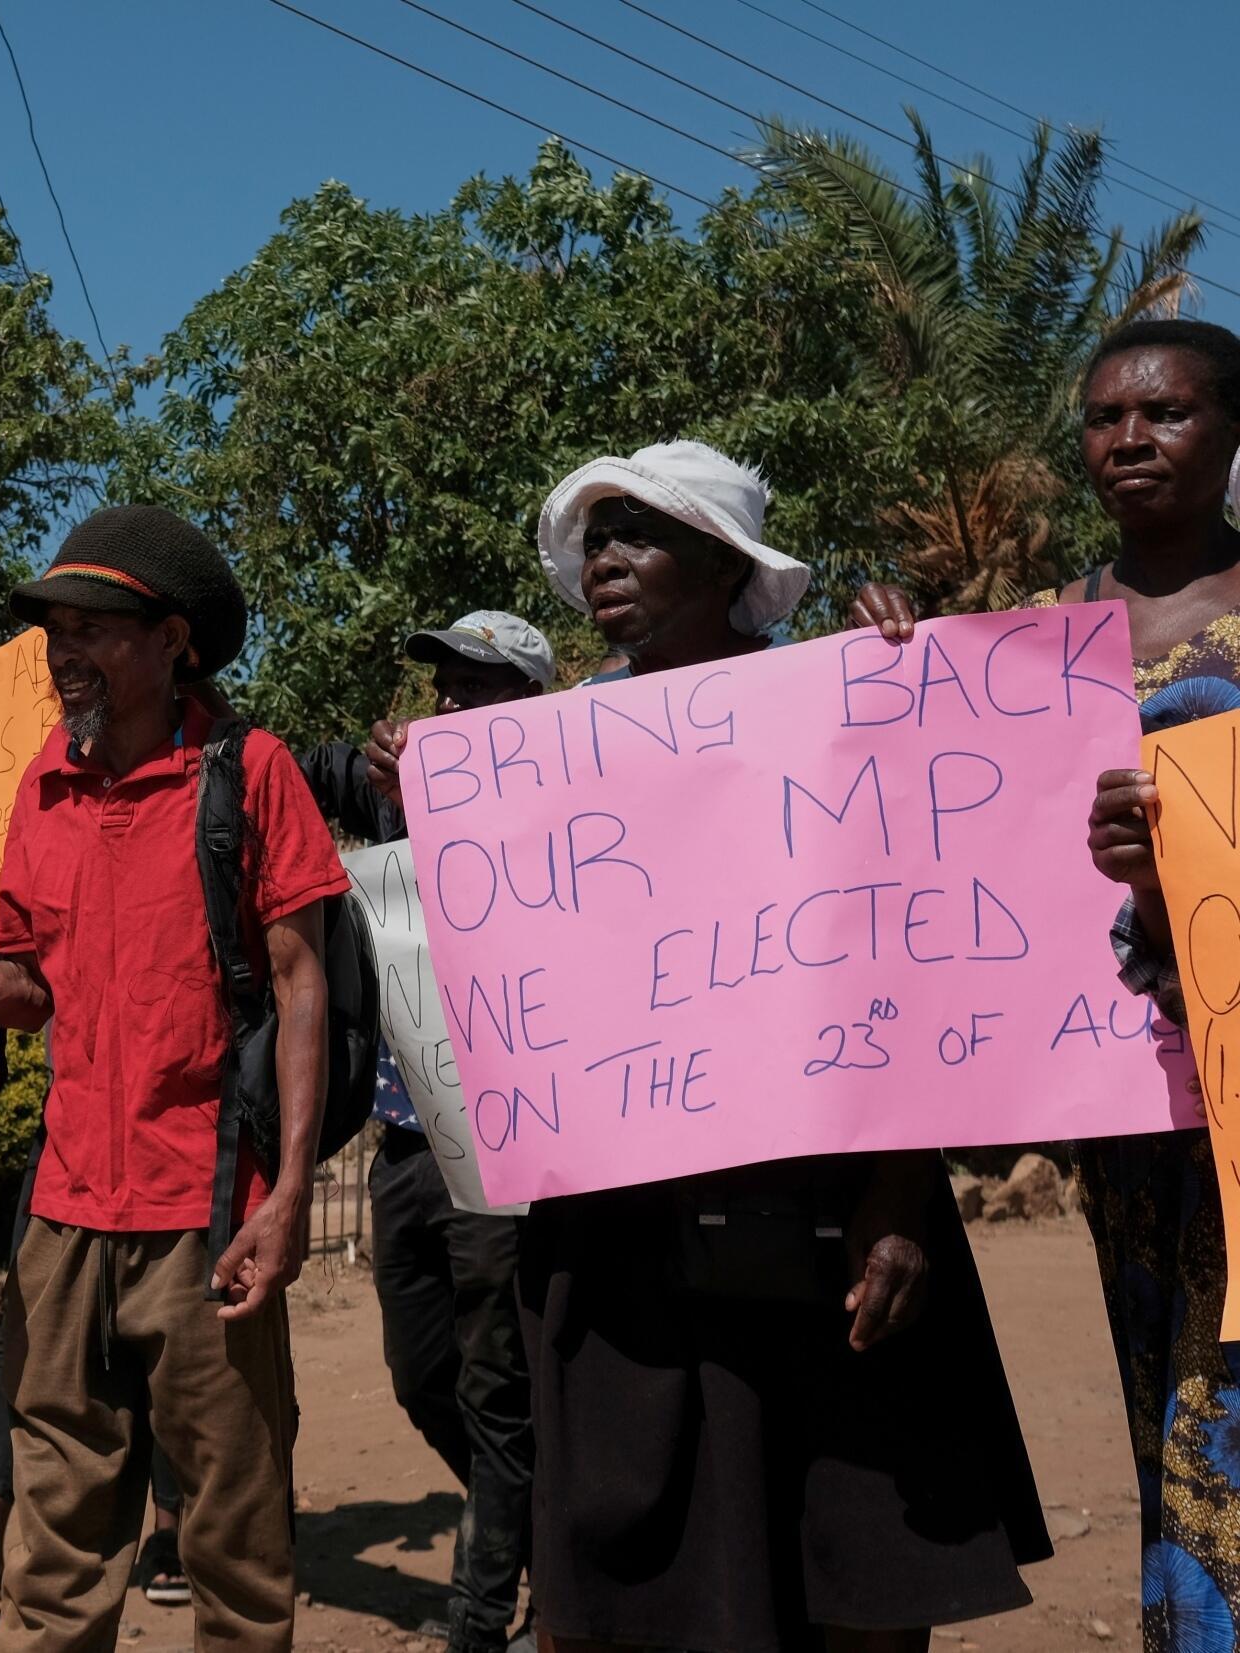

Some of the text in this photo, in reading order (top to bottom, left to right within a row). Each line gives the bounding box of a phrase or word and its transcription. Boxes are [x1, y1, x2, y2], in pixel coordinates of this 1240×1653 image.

[417, 611, 1138, 814] BRING BACK
[436, 811, 654, 932] OUR
[783, 750, 1004, 862] MP
[443, 966, 569, 1056] WE
[650, 876, 1030, 1012] ELECTED
[475, 1071, 561, 1152] ON
[584, 1039, 717, 1118] THE
[938, 1011, 1004, 1066] OF
